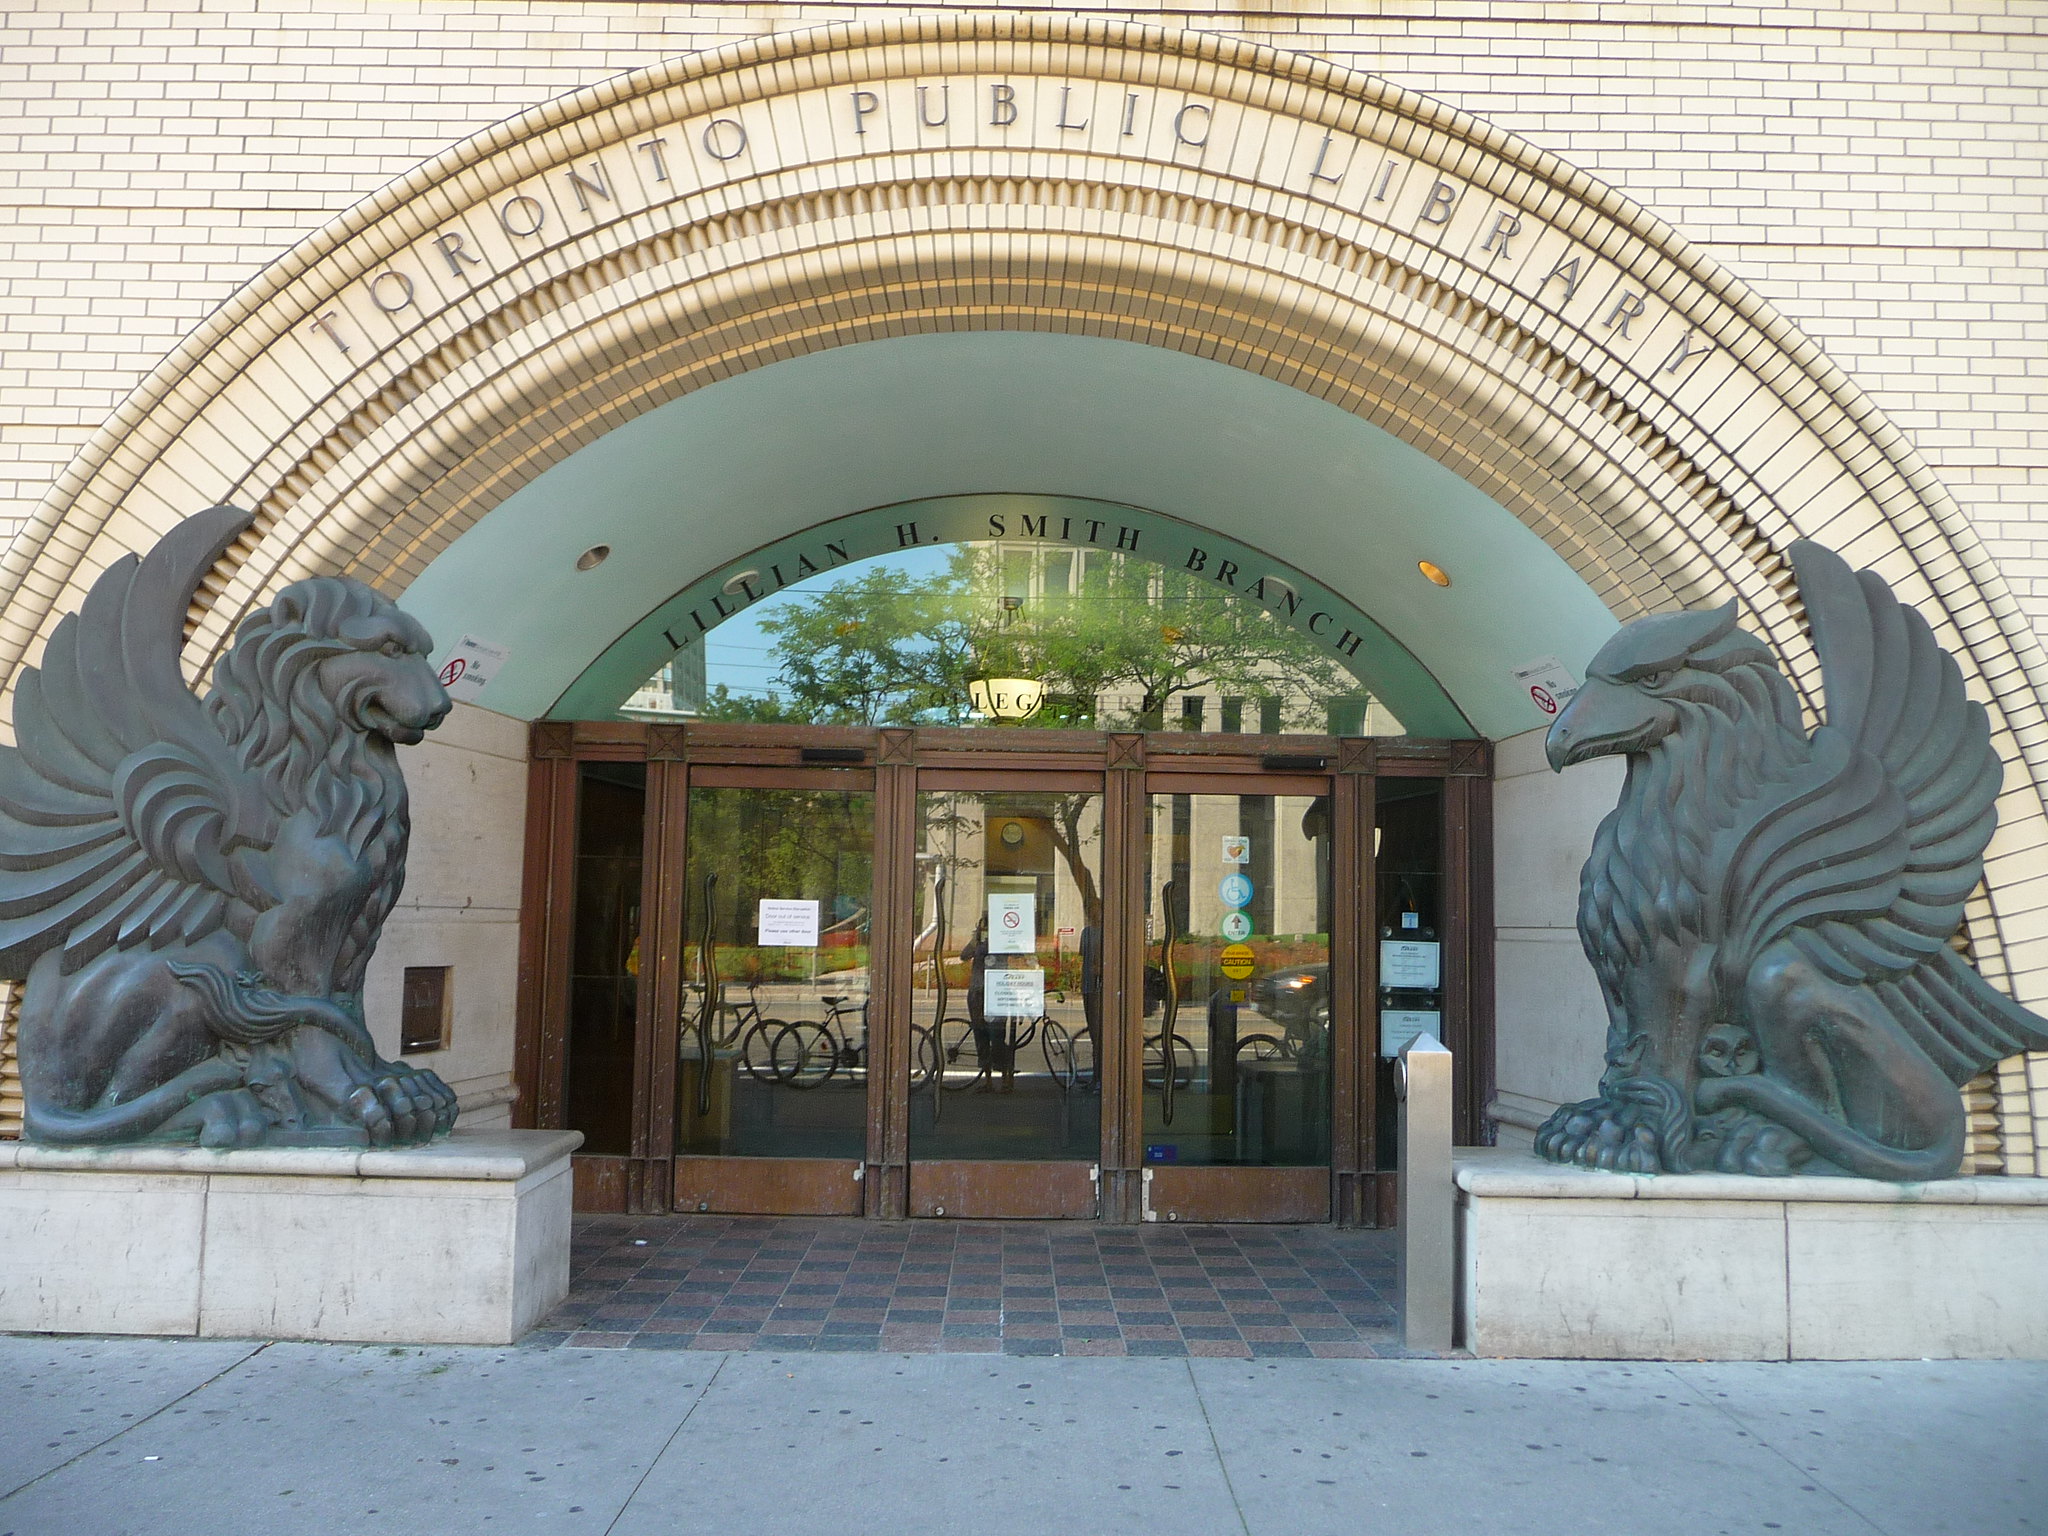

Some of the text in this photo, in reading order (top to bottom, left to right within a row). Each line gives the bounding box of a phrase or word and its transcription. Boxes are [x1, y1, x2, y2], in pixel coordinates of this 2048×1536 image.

[310, 84, 1712, 378] TORONTO PUBLIC LIBRARY
[662, 513, 1364, 658] LILLIAN H. SMITH BRANCH
[1223, 958, 1252, 966] CAUTION
